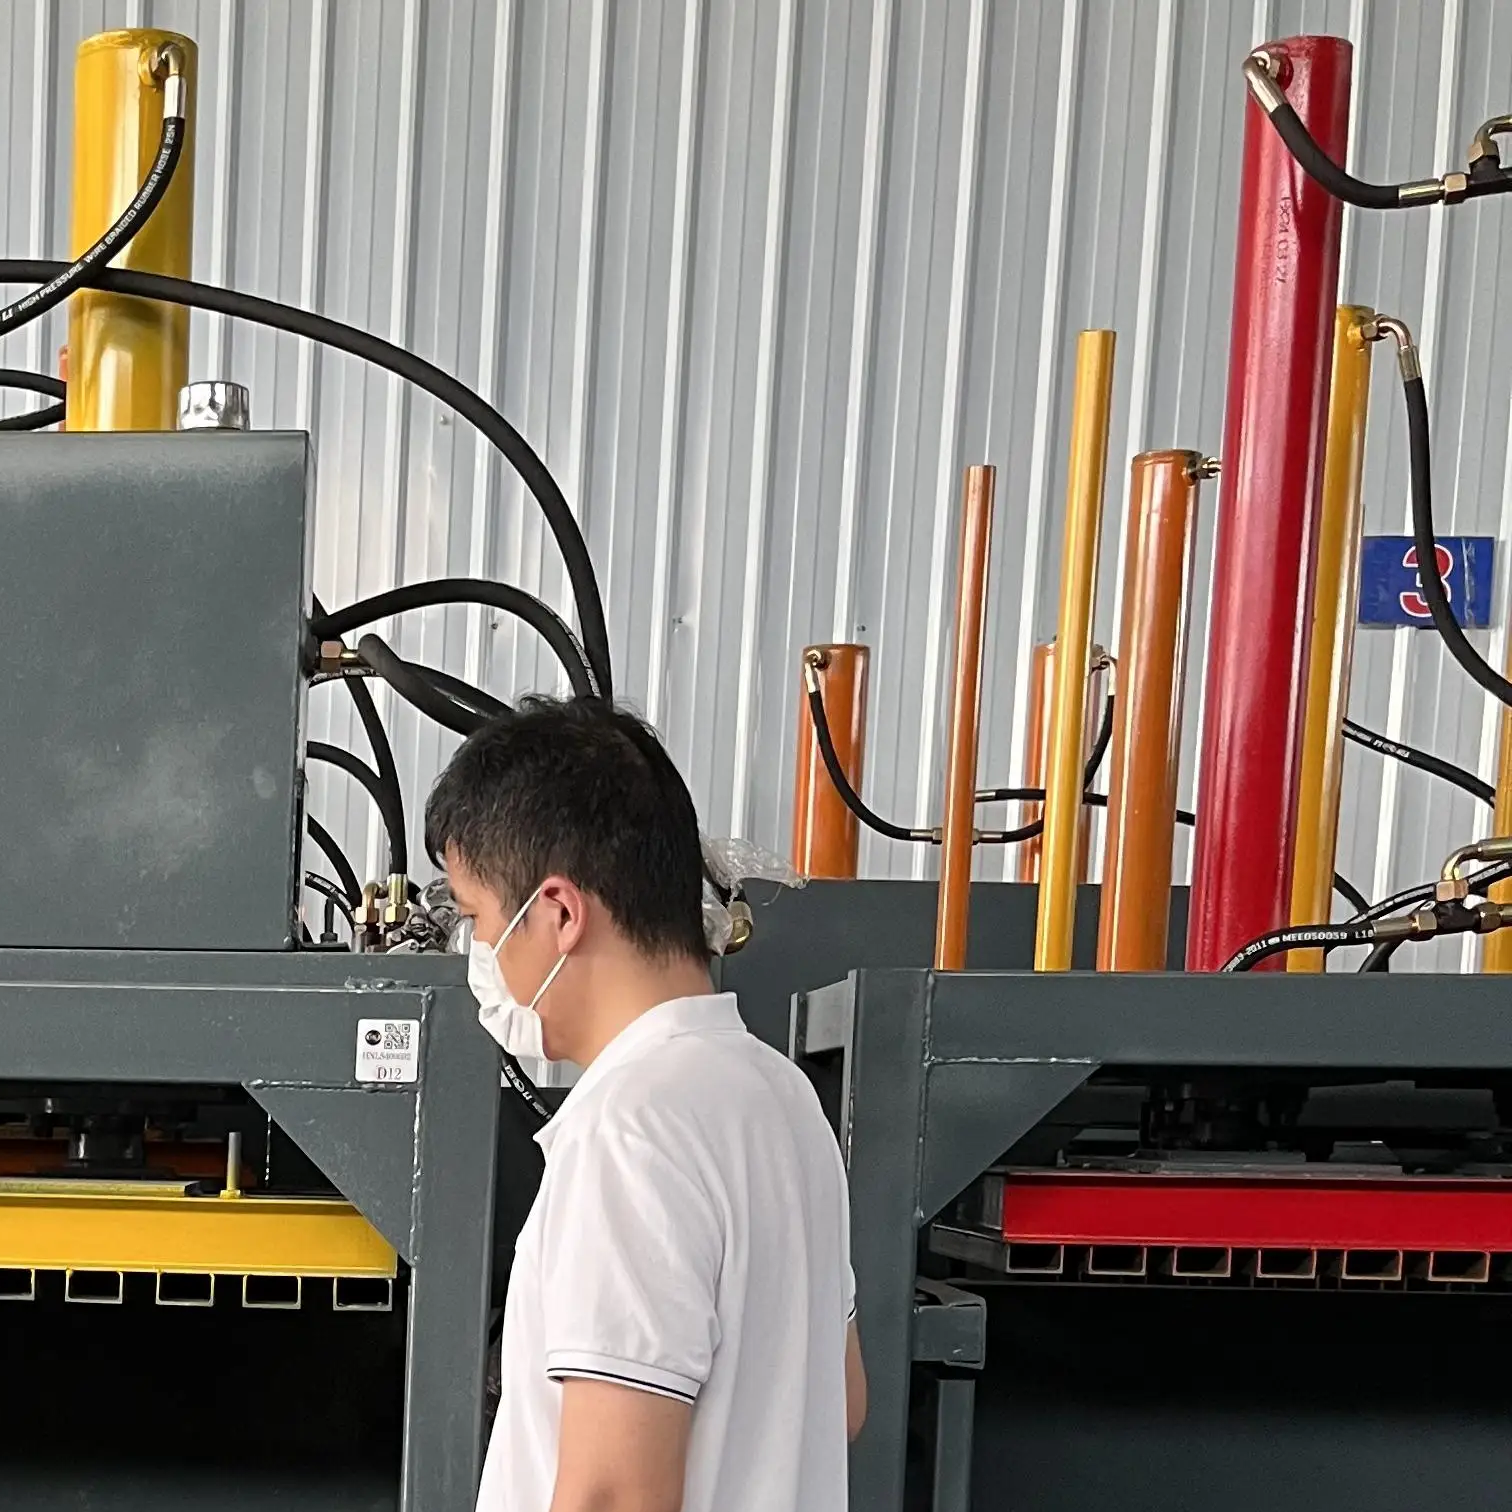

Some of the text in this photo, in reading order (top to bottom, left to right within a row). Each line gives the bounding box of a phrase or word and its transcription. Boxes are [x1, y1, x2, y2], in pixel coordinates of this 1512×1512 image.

[1, 308, 14, 322] LI
[18, 295, 40, 311] HIGH
[39, 261, 85, 298] PRESSURE
[83, 242, 107, 264] WIRE
[104, 209, 137, 245] BRAIDED
[133, 173, 161, 211] RUBBER
[155, 148, 172, 175] HOSE
[1399, 543, 1454, 618] 3
[376, 1066, 402, 1080] D12
